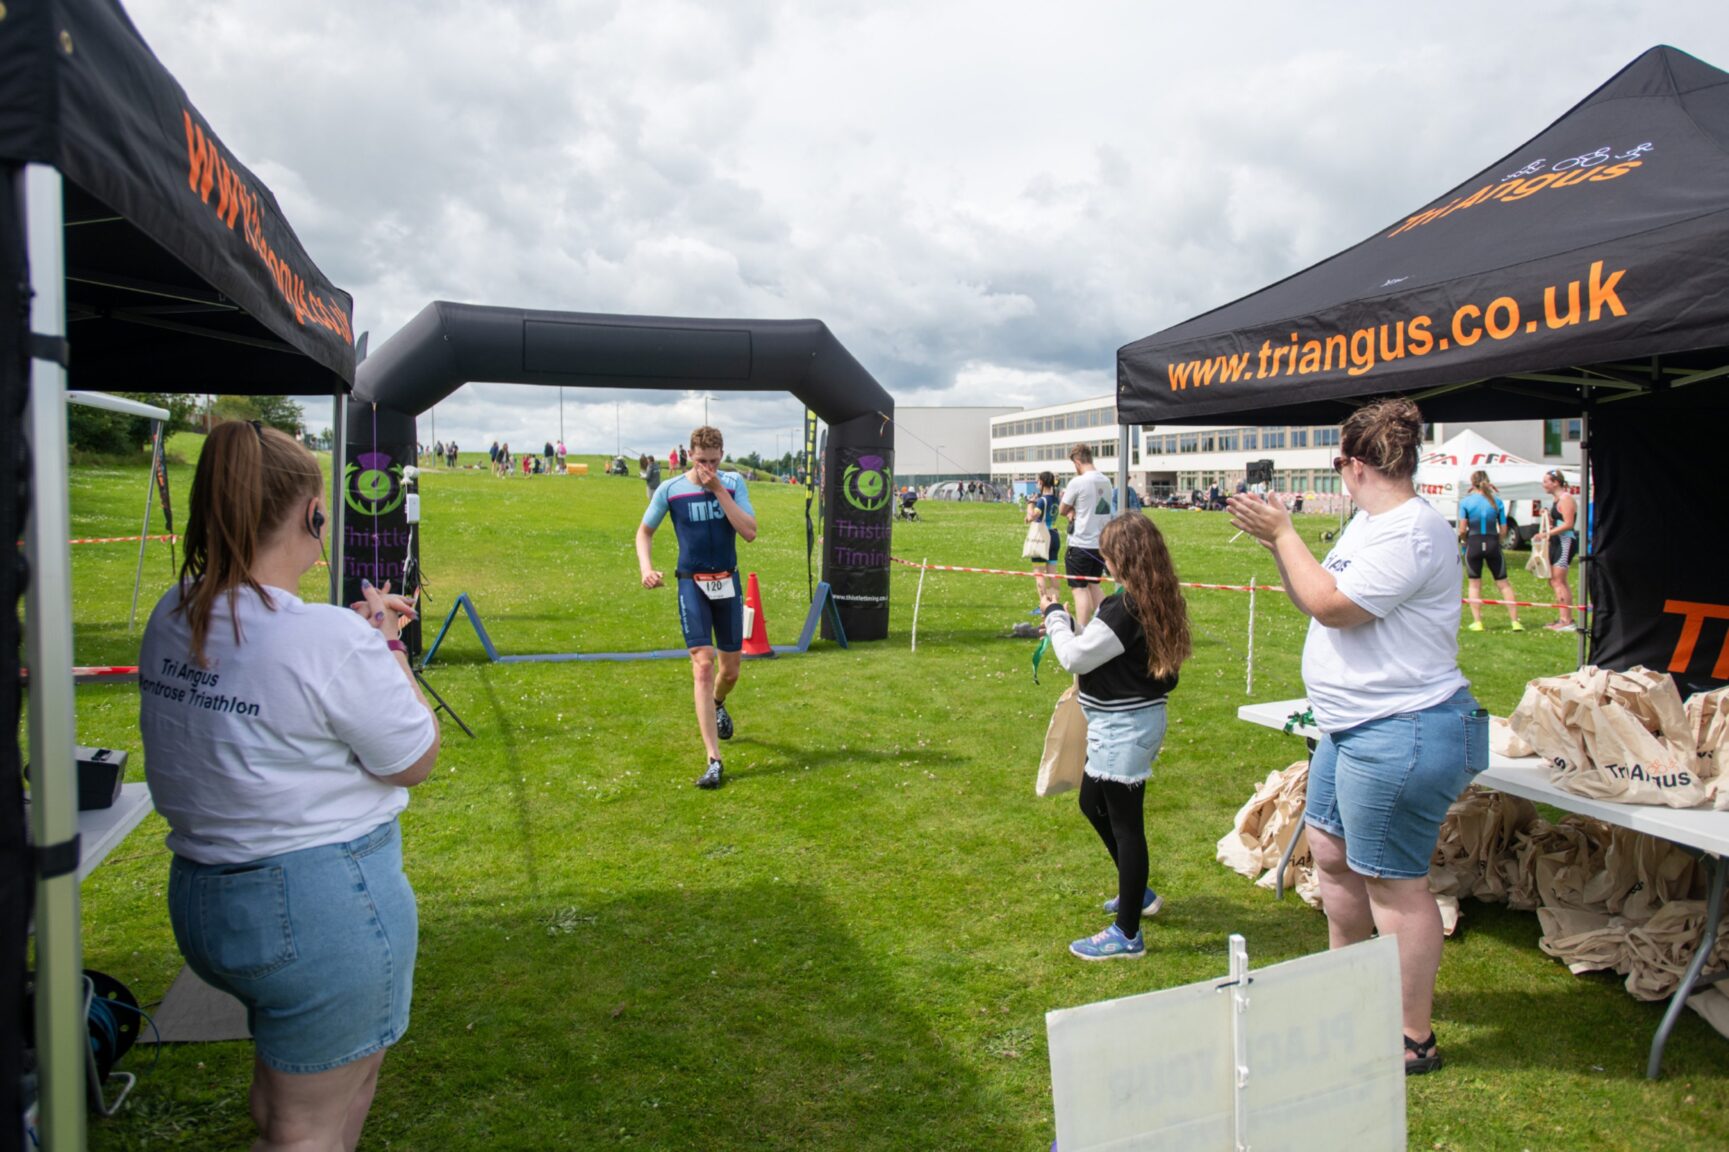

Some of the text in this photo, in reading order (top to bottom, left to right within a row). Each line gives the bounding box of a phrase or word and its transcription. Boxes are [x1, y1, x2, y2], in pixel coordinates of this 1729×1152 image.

[1167, 260, 1628, 393] www.triangus.co.uk
[706, 581, 723, 592] 120
[189, 688, 260, 716] Triathlon
